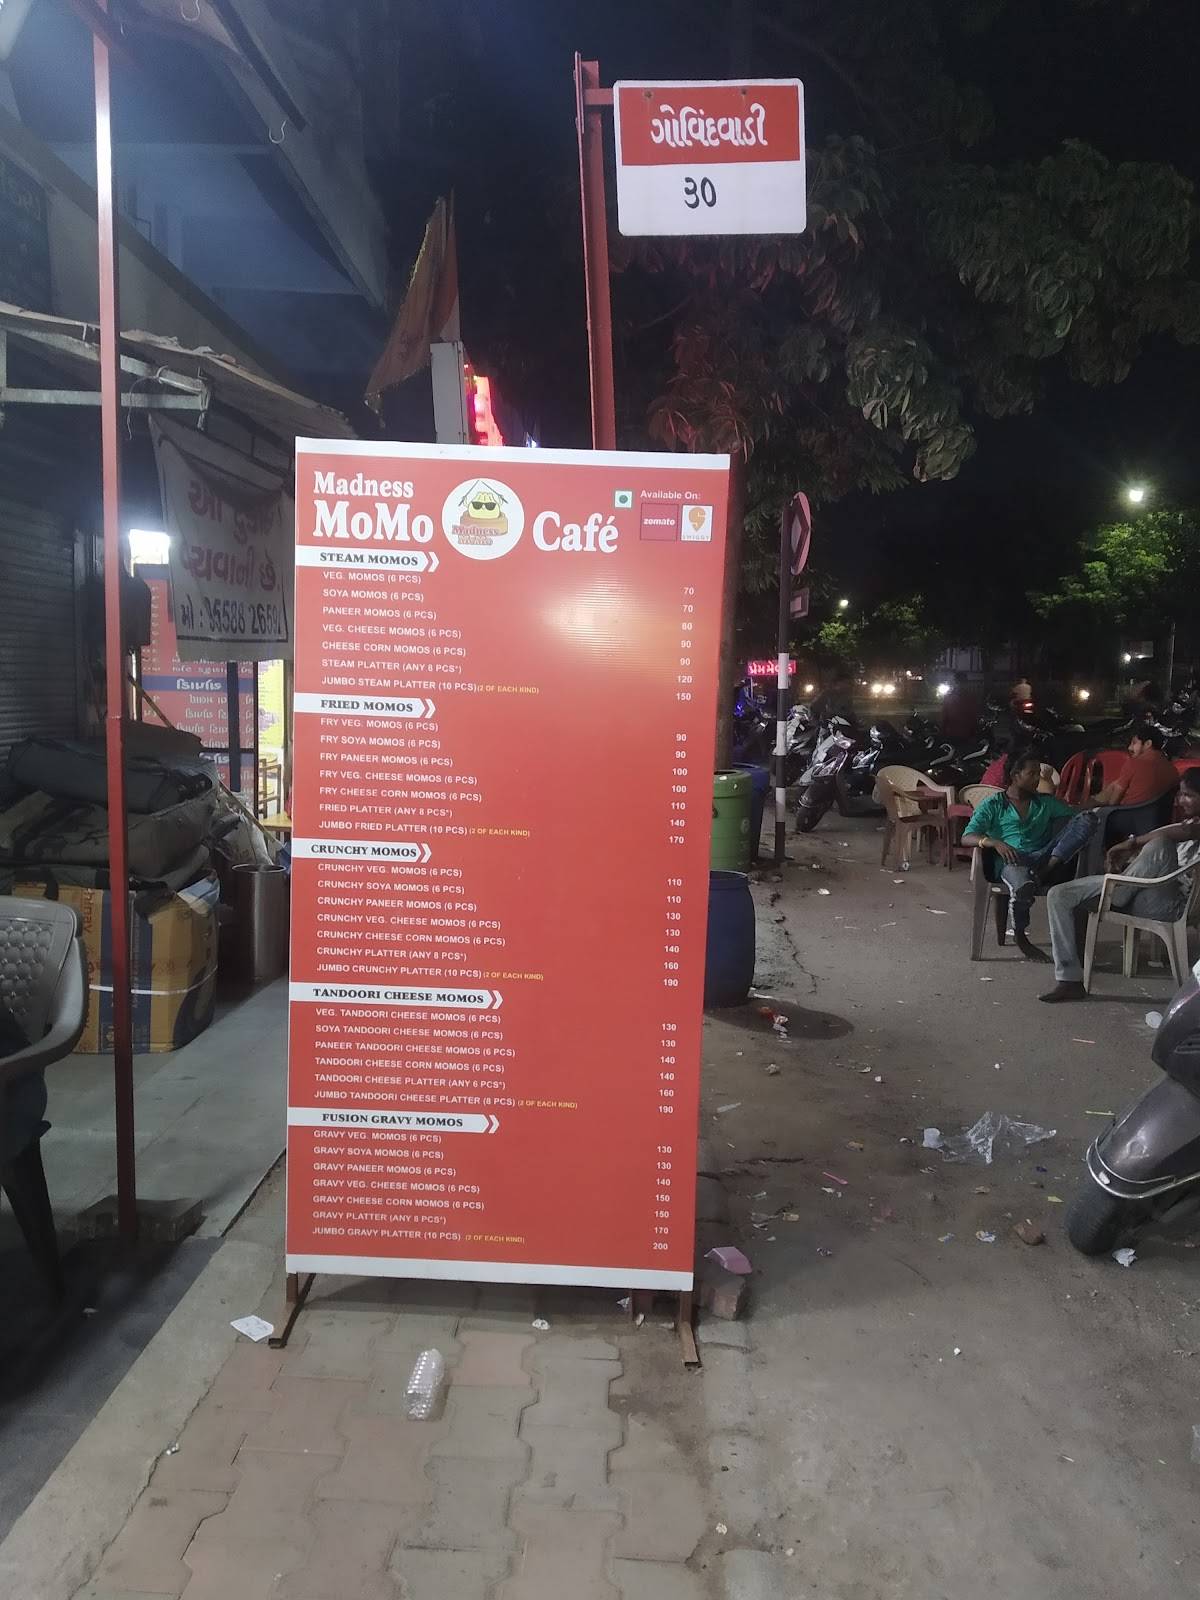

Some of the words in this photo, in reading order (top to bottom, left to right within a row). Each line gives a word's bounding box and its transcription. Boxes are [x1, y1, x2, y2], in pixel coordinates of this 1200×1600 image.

[651, 103, 768, 148] ગોવિંદવાડી
[684, 177, 717, 208] ૩૦
[313, 471, 414, 498] Madness
[640, 490, 682, 500] Available
[684, 491, 701, 500] On:
[312, 500, 434, 543] MoMo
[532, 510, 619, 553] Café
[643, 518, 676, 526] zomato
[452, 524, 500, 536] Madness
[320, 552, 363, 563] STEAM
[368, 554, 417, 565] MOMOS
[322, 588, 348, 597] SOYA
[351, 590, 387, 599] MOMOS
[401, 592, 424, 602] PCS)
[683, 587, 694, 595] 70
[322, 606, 360, 615] PANEER
[363, 608, 400, 617] MOMOS
[414, 610, 436, 620] PCS)
[682, 604, 693, 612] 70
[322, 640, 360, 650] CHEESE
[363, 643, 391, 652] CORN
[393, 644, 430, 654] MOMOS
[443, 646, 466, 657] PCS)
[680, 657, 690, 665] 90
[677, 672, 692, 683] 120
[322, 675, 355, 685] JUMBO
[358, 678, 390, 687] STEAM
[393, 679, 435, 689] PLATTER
[454, 682, 476, 692] PCS)
[676, 690, 691, 700] 150
[321, 699, 359, 709] FRIED
[363, 701, 412, 712] MOMOS
[320, 734, 338, 743] FRY
[341, 735, 366, 744] SOYA
[369, 737, 404, 746] MOMOS
[418, 739, 440, 749] PCS)
[675, 733, 686, 741] 90
[675, 750, 686, 758] 90
[320, 752, 337, 760] FRY
[340, 753, 378, 762] PANEER
[381, 753, 417, 764] MOMOS
[430, 757, 453, 767] PCS)
[672, 767, 687, 775] 100
[671, 784, 686, 793] 100
[671, 799, 685, 809] 110
[319, 803, 347, 812] FRIED
[349, 805, 391, 815] PLATTER
[393, 807, 416, 816] (ANY
[669, 835, 684, 843] 170
[311, 844, 368, 855] CRUNCHY
[371, 846, 416, 857] MOMOS
[317, 879, 363, 889] CRUNCHY
[366, 881, 391, 890] SOYA
[393, 881, 429, 892] MOMOS
[442, 885, 464, 894] PCS)
[667, 878, 681, 886] 110
[317, 895, 363, 906] CRUNCHY
[365, 898, 403, 908] PANEER
[406, 900, 441, 909] MOMOS
[454, 902, 477, 912] PCS)
[666, 895, 681, 903] 110
[666, 912, 680, 920] 130
[665, 928, 680, 936] 130
[317, 946, 362, 957] CRUNCHY
[364, 948, 406, 957] PLATTER
[409, 950, 431, 959] (ANY
[664, 945, 679, 953] 140
[663, 960, 678, 969] 160
[663, 977, 678, 986] 190
[312, 988, 380, 999] TANDOORI
[384, 991, 432, 1001] CHEESE
[436, 993, 483, 1003] MOMOS
[315, 1023, 340, 1033] SOYA
[343, 1024, 390, 1034] TANDOORI
[393, 1027, 429, 1036] CHEESE
[433, 1029, 468, 1039] MOMOS
[481, 1031, 503, 1040] PCS)
[661, 1023, 676, 1031] 130
[661, 1039, 675, 1047] 130
[315, 1040, 352, 1049] PANEER
[354, 1041, 402, 1051] TANDOORI
[405, 1044, 442, 1053] CHEESE
[445, 1046, 480, 1055] MOMOS
[493, 1048, 515, 1057] PCS)
[660, 1056, 675, 1064] 140
[659, 1072, 674, 1080] 140
[659, 1089, 674, 1097] 160
[658, 1105, 673, 1113] 190
[322, 1113, 367, 1123] FUSION
[371, 1115, 411, 1124] GRAVY
[416, 1117, 462, 1127] MOMOS
[313, 1146, 345, 1154] GRAVY
[347, 1147, 372, 1155] SOYA
[374, 1148, 409, 1157] MOMOS
[422, 1150, 443, 1160] PCS)
[657, 1144, 672, 1153] 130
[313, 1162, 344, 1171] GRAVY
[347, 1163, 384, 1172] PANEER
[386, 1165, 421, 1174] MOMOS
[434, 1167, 456, 1177] PCS)
[657, 1161, 671, 1169] 130
[656, 1177, 670, 1185] 140
[312, 1195, 344, 1203] GRAVY
[346, 1196, 382, 1205] CHEESE
[385, 1198, 412, 1206] CORN
[414, 1199, 449, 1208] MOMOS
[462, 1201, 484, 1210] PCS)
[655, 1194, 670, 1202] 150
[654, 1208, 669, 1218] 150
[654, 1226, 668, 1234] 170
[652, 1242, 668, 1250] 200
